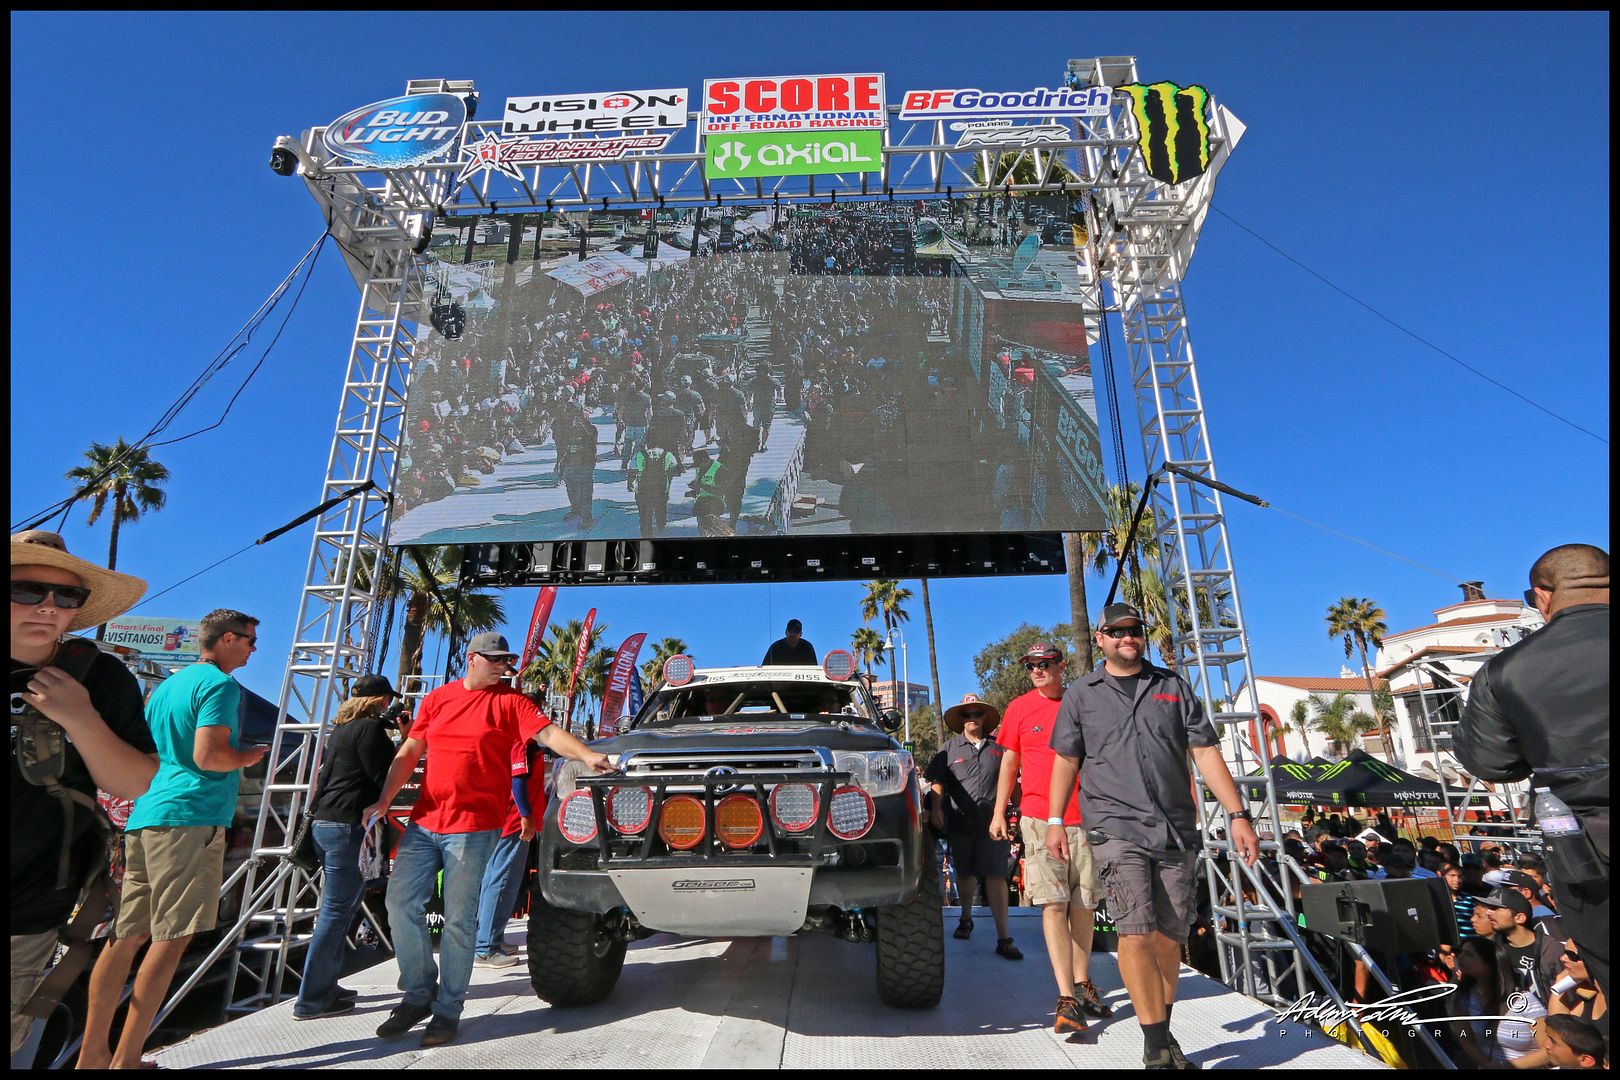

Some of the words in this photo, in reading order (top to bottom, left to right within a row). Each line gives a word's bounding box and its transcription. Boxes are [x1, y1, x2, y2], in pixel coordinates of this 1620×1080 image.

[708, 76, 881, 115] SCORE
[904, 88, 1108, 111] BFGoodrich
[367, 110, 449, 127] BUD
[504, 114, 684, 133] WHEEL
[709, 111, 881, 123] INTERNATIONAL
[967, 120, 1011, 129] POLARIS
[707, 120, 802, 132] OFF-ROAD
[809, 119, 882, 128] RACING
[344, 126, 458, 144] LIGHT
[508, 143, 556, 153] RIGID
[556, 137, 664, 151] INDUSTRIES
[503, 152, 537, 162] LED
[540, 148, 622, 160] LIGHTING
[794, 673, 821, 681] 8155
[1394, 790, 1441, 801] MONSTER
